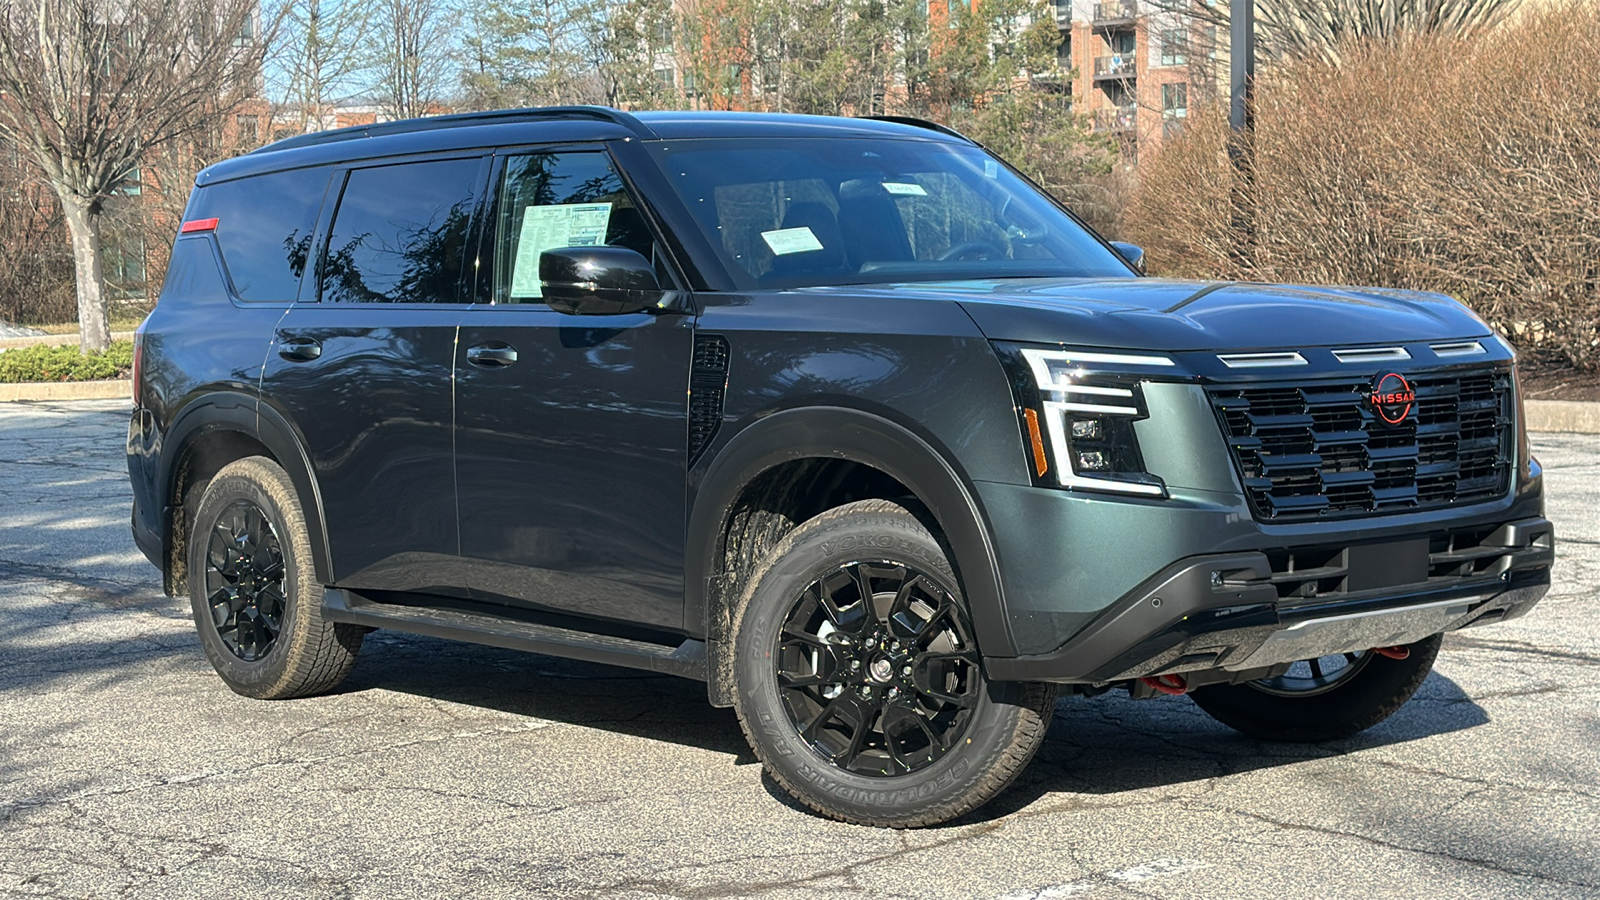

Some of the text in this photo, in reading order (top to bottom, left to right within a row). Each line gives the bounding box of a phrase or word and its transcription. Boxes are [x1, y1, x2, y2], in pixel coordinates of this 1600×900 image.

[1371, 392, 1415, 404] NISSAN
[754, 706, 969, 806] GEOLANDAR A/T
